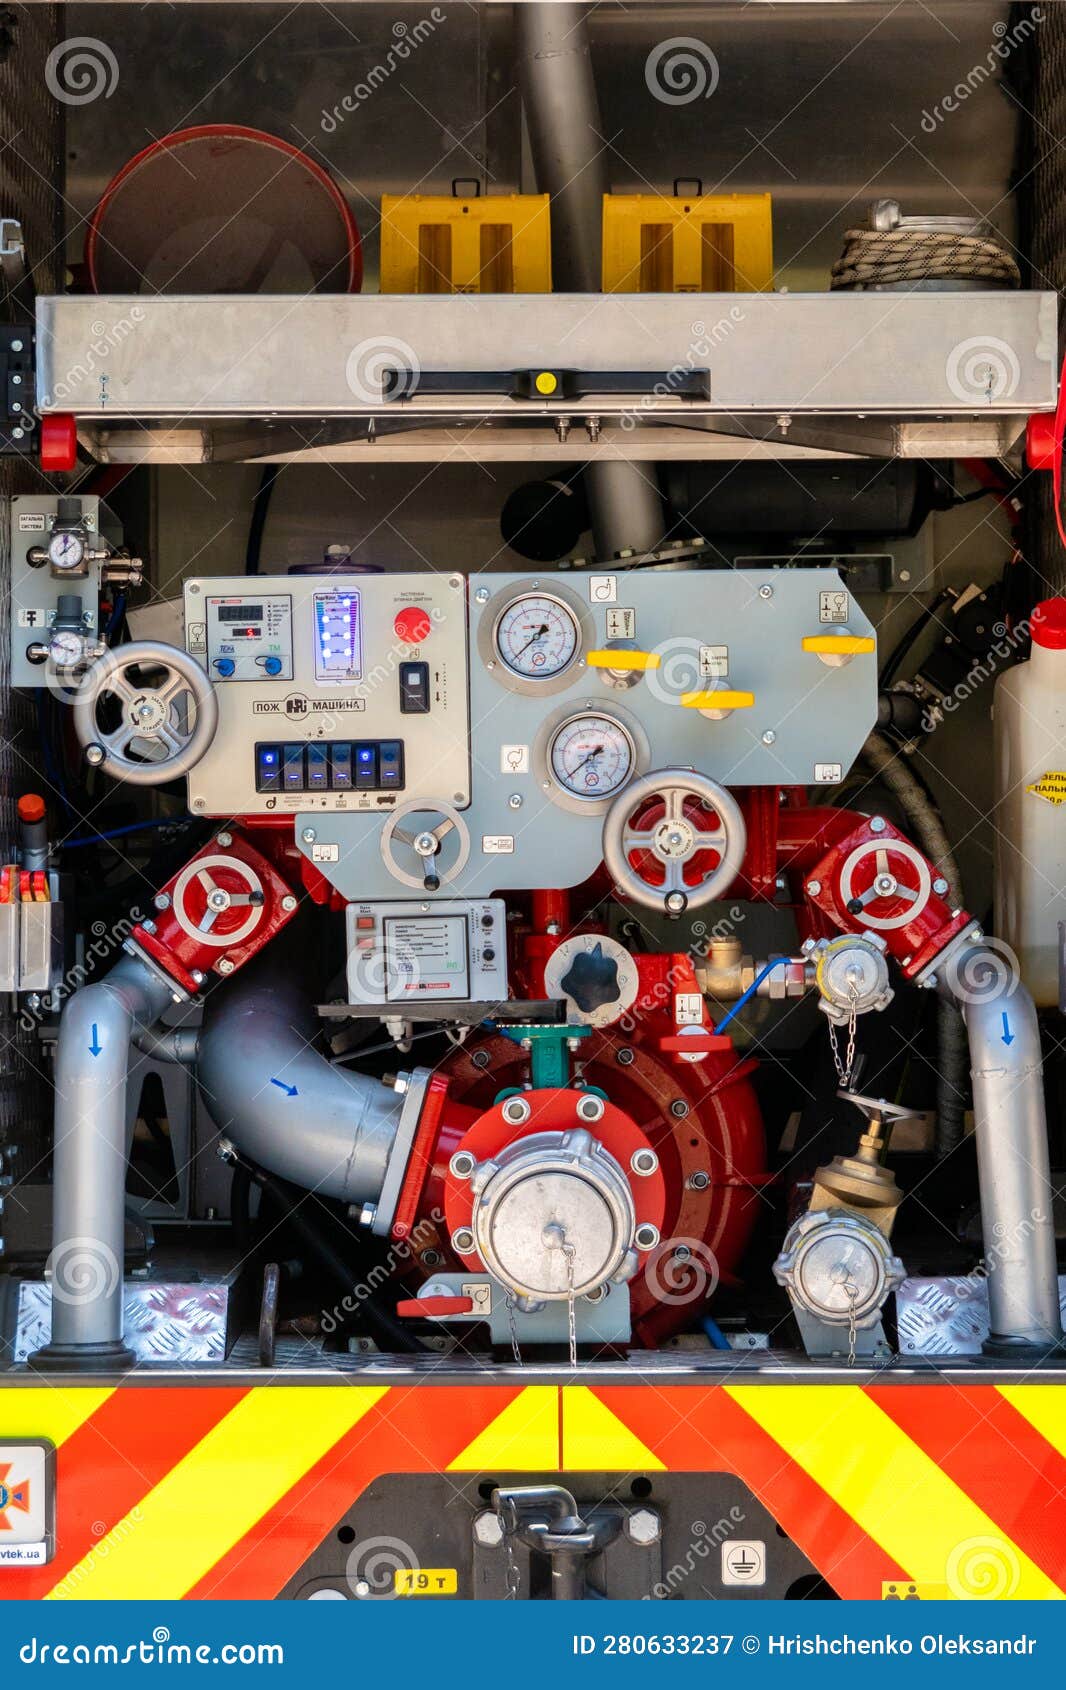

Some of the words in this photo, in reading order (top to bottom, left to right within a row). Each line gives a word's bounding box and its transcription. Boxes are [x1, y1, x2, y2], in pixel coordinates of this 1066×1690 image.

[256, 703, 280, 712] ПОЖ
[312, 701, 360, 711] МАШИНА
[0, 1549, 40, 1559] vtek.ua
[404, 1573, 429, 1589] 19
